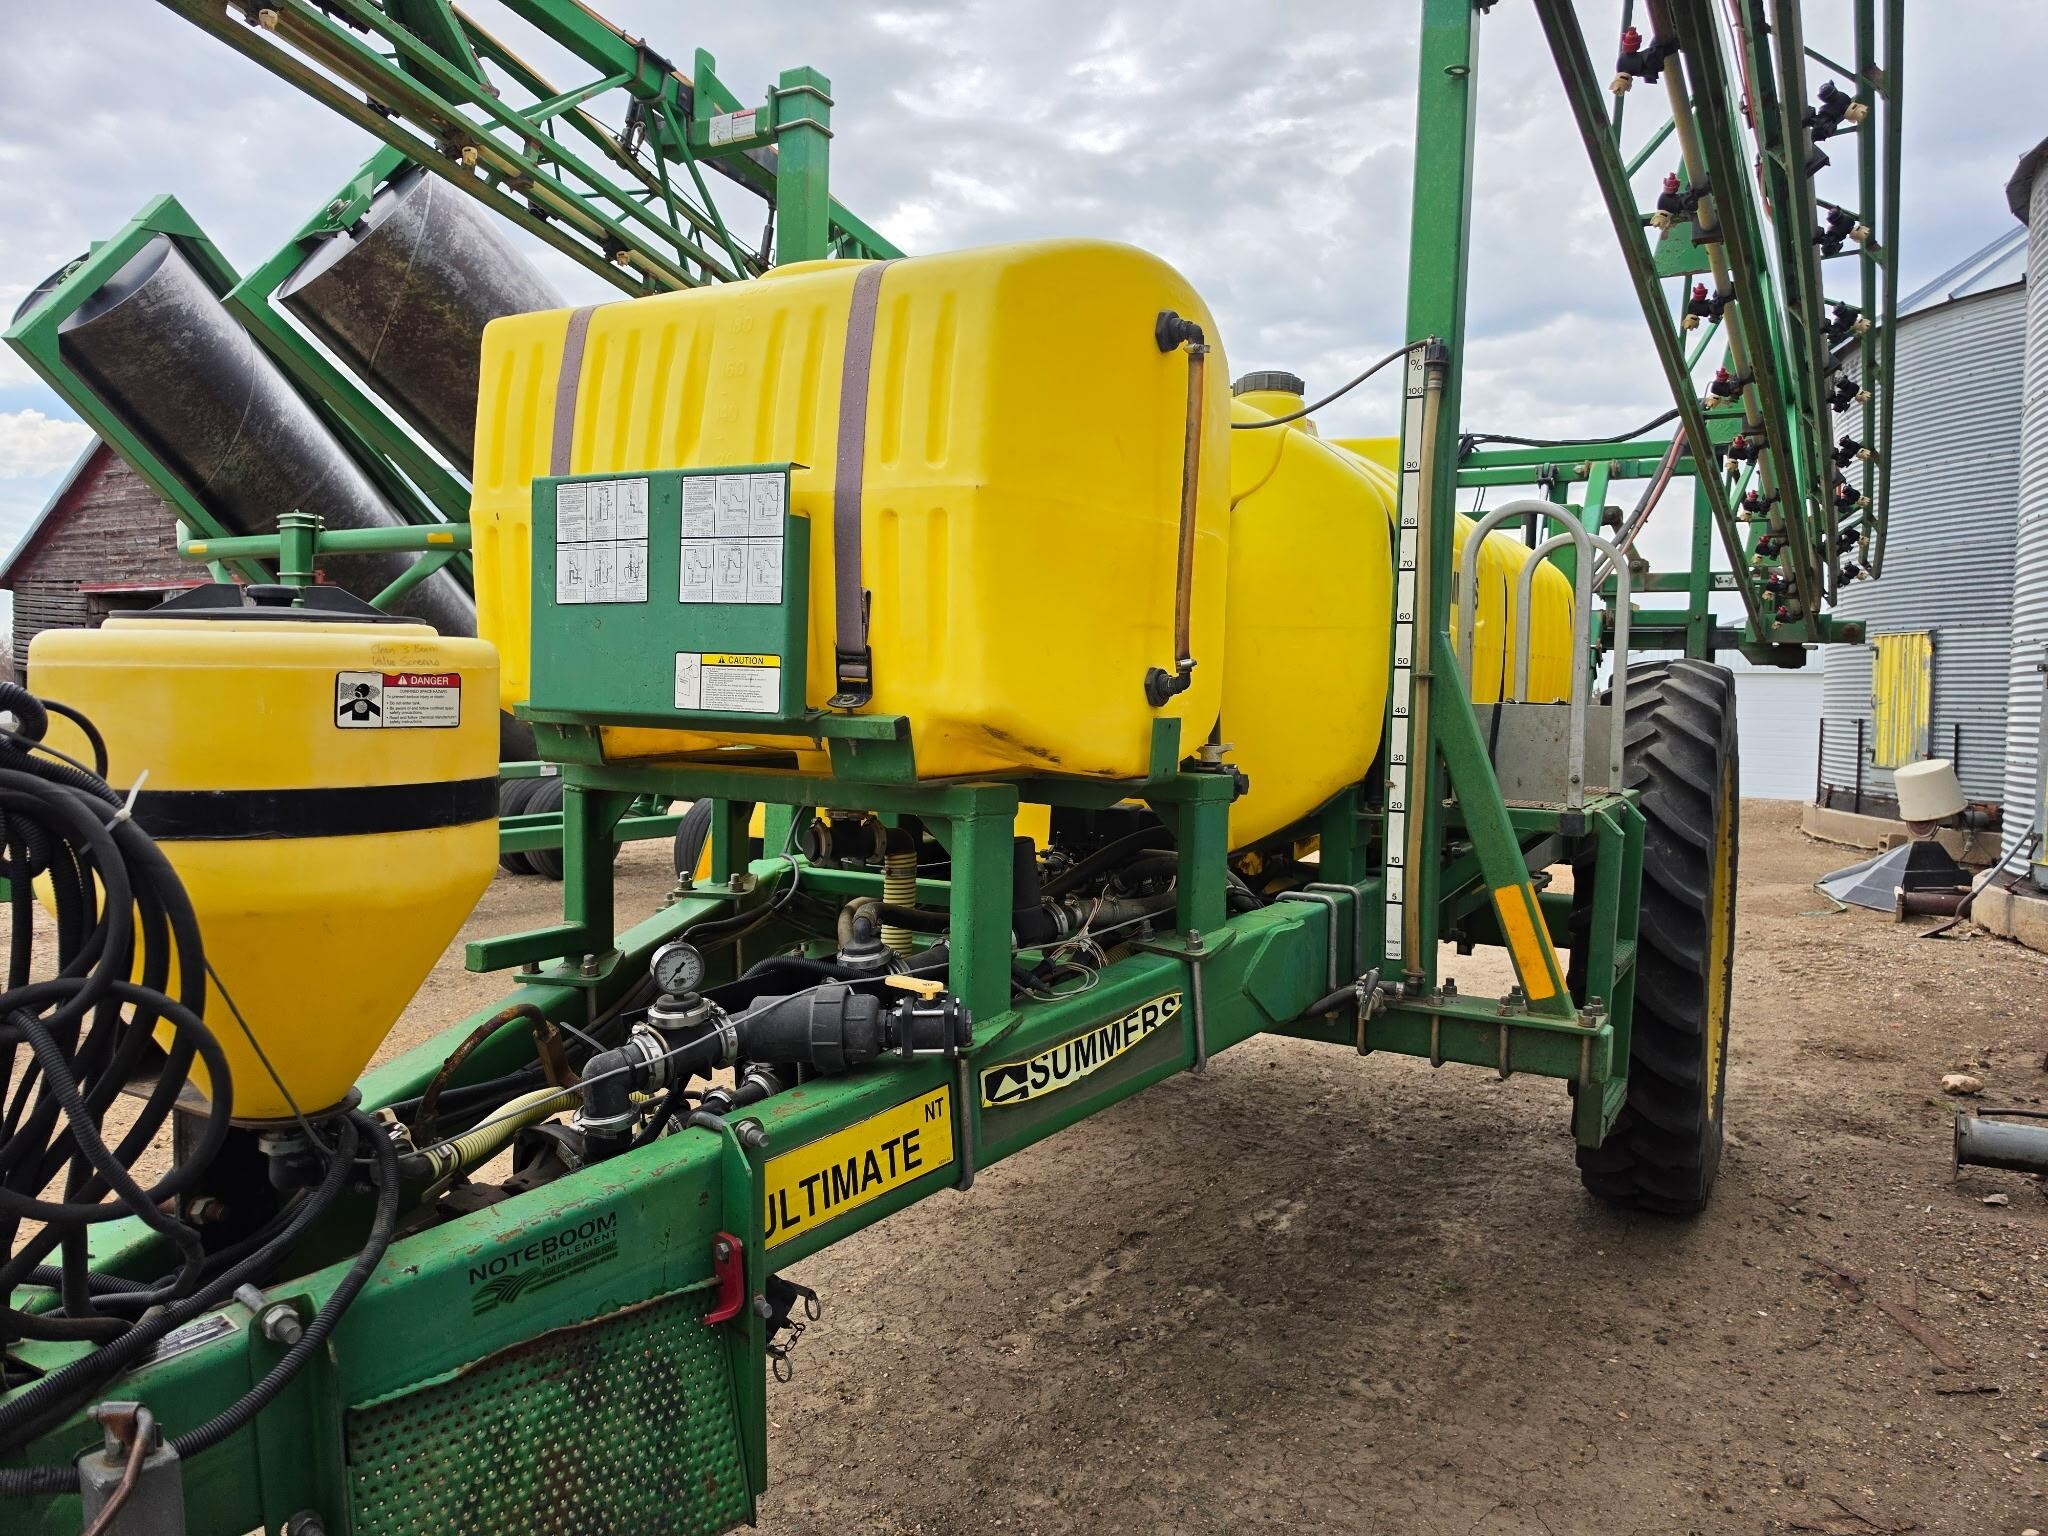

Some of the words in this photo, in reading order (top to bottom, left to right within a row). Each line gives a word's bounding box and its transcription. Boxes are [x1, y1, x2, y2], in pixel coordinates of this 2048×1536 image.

[1410, 359, 1423, 371] %
[1408, 387, 1423, 395] 100
[1406, 461, 1418, 469] 90
[1403, 517, 1415, 525] 80
[1402, 560, 1413, 568] 70
[1399, 612, 1411, 620] 60
[728, 656, 764, 665] CAUTION
[1397, 657, 1409, 665] 50
[410, 676, 449, 685] DANGER
[1394, 706, 1406, 714] 40
[1391, 801, 1403, 809] 20
[1391, 856, 1400, 864] 10
[1030, 996, 1176, 1089] SUMMERS
[925, 1096, 944, 1123] NT
[469, 1212, 616, 1285] NOTEBOOM
[542, 1229, 617, 1267] IMPLEMENT
